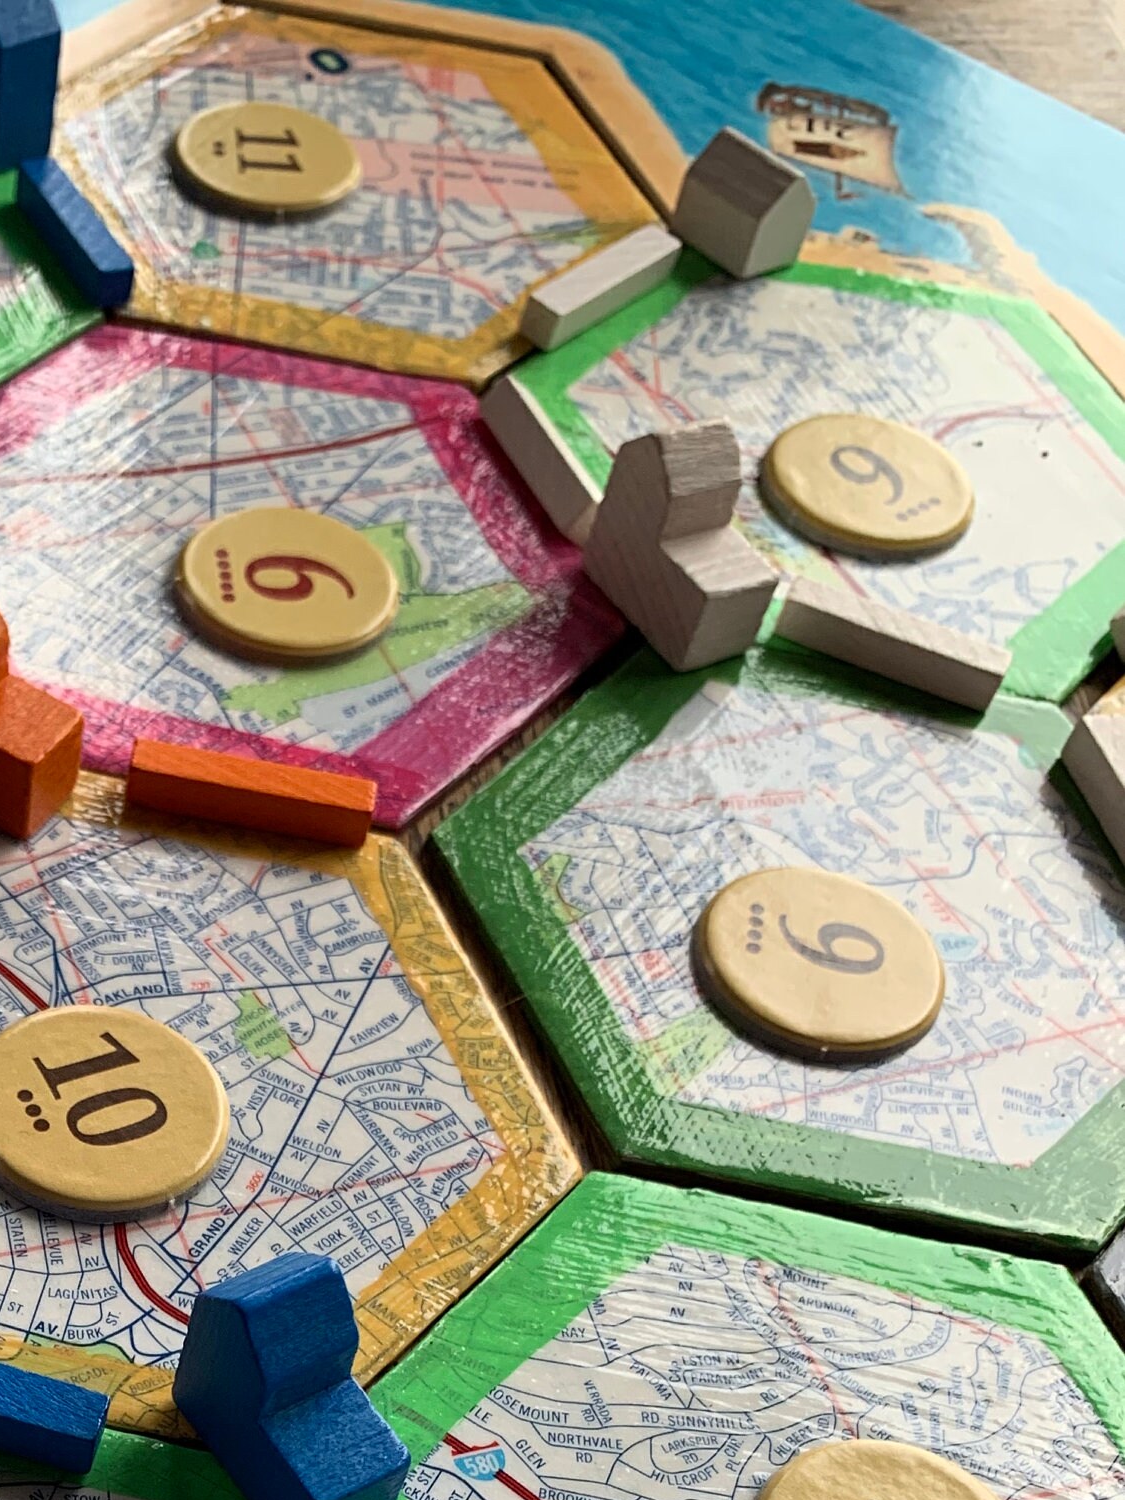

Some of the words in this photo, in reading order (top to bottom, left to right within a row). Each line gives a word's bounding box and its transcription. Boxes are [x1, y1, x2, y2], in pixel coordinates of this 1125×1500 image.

[234, 127, 303, 176] 11
[244, 553, 355, 601] 6
[349, 1013, 399, 1046] FAIRVIEW
[334, 1062, 403, 1086] WILDWOOD
[33, 1031, 168, 1147] 10
[359, 1082, 400, 1096] SYLVAN
[372, 1101, 442, 1111] BOULEVARD
[292, 1135, 342, 1159] WELDON
[355, 1107, 401, 1159] FAIRBANKS
[271, 1170, 323, 1196] DAVIDSON
[336, 1155, 381, 1193] VERMONT
[289, 1200, 343, 1236] WARFIELD
[189, 1216, 226, 1258] GRAND
[343, 1216, 376, 1252] PRINCE
[47, 1284, 118, 1300] LAGUNITAS
[628, 1361, 672, 1402] PALOMA
[584, 1379, 613, 1424] VERRADA
[667, 1415, 756, 1429] SUNNYHILLS
[547, 1431, 623, 1450] NORTHVALE
[661, 1436, 719, 1453] LARKSPUR
[465, 1454, 499, 1473] 580
[650, 1466, 719, 1489] HILLCROFT
